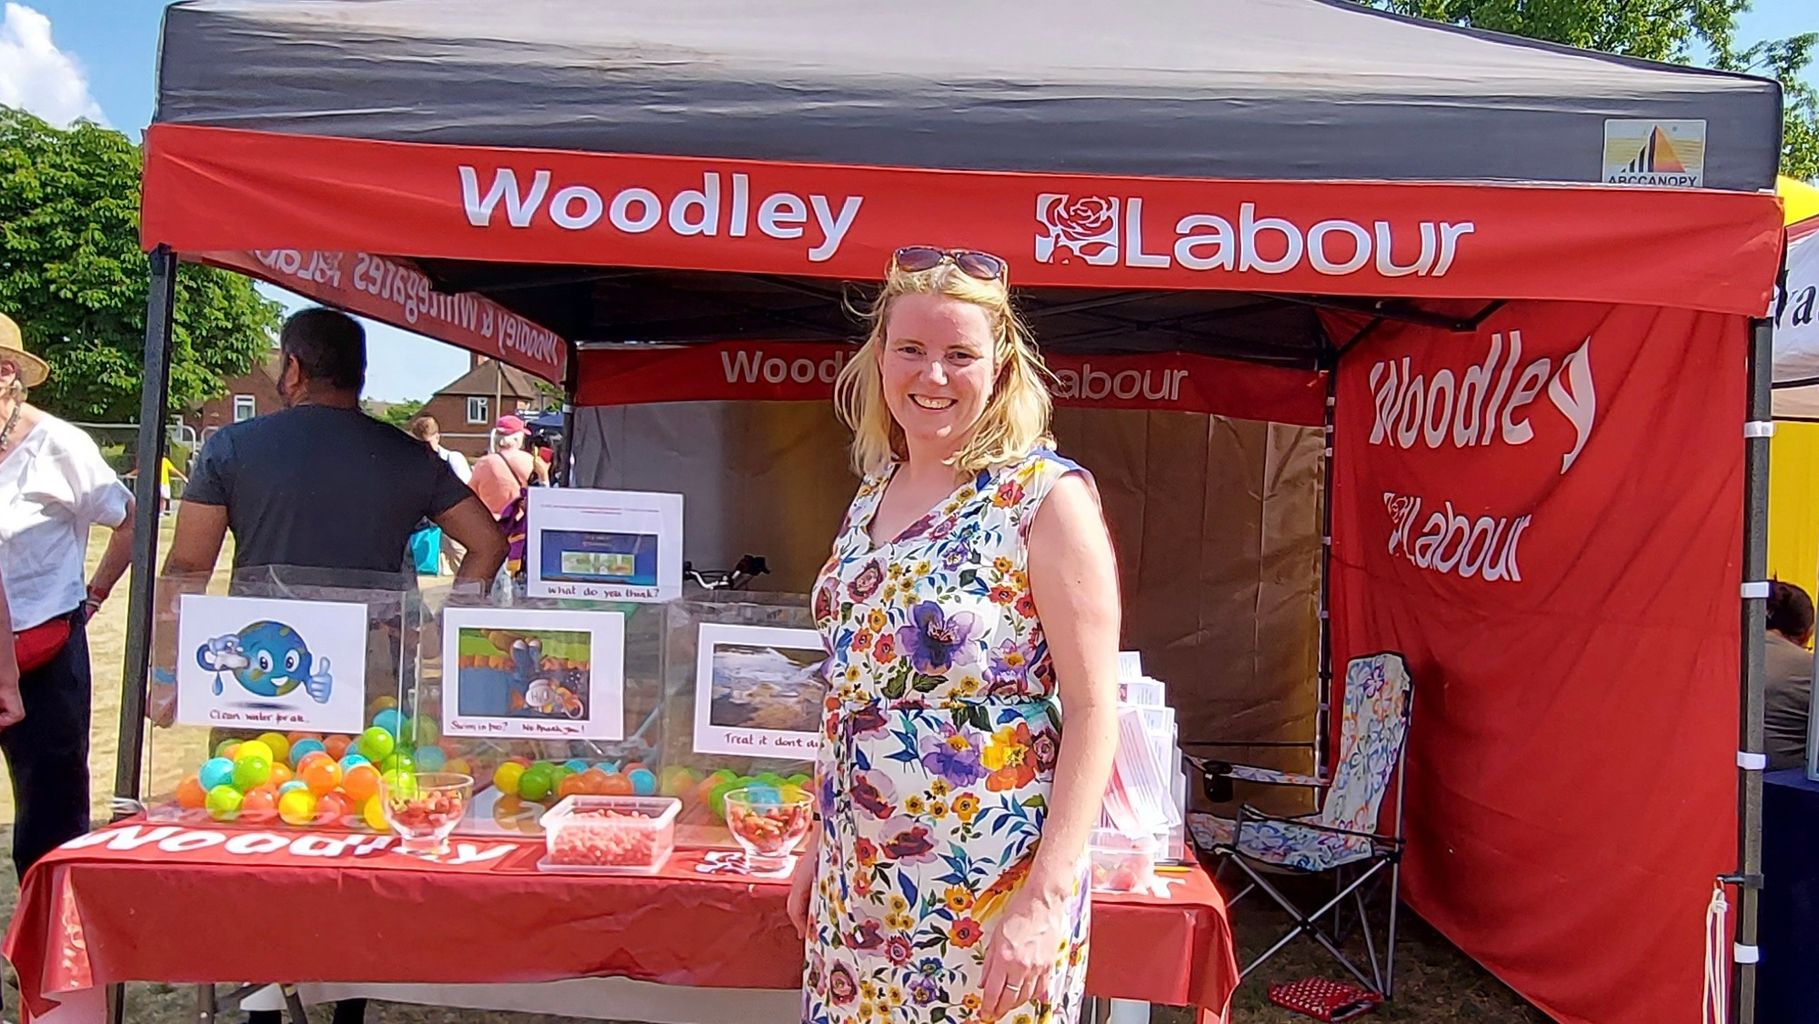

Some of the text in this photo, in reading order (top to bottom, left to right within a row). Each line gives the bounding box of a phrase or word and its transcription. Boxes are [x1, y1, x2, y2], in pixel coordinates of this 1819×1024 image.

[458, 165, 1474, 278] Woodley Labour
[1050, 363, 1189, 401] abour
[1369, 330, 1596, 475] Woodley
[1402, 497, 1532, 582] Labour
[583, 587, 599, 597] do
[724, 732, 754, 745] Treat
[759, 735, 767, 745] it
